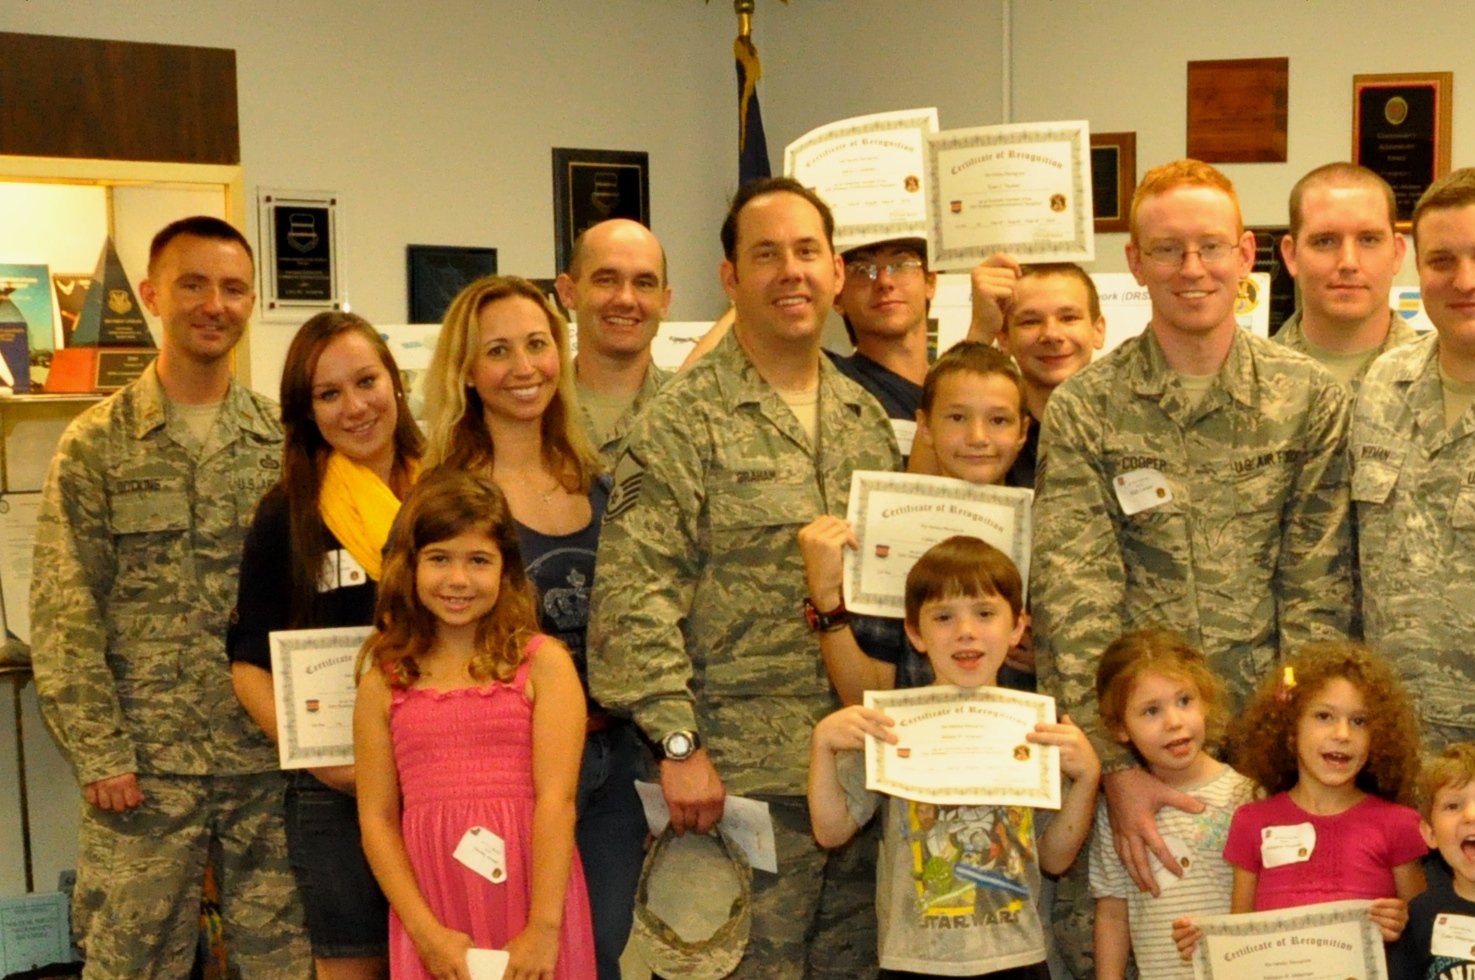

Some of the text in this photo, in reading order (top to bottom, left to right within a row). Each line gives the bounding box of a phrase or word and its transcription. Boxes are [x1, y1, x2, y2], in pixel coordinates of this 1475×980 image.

[951, 150, 1063, 175] Certificate of Recognition
[1121, 456, 1167, 470] COOPER
[882, 504, 932, 519] Certificate
[936, 504, 945, 512] of
[950, 505, 1004, 533] Recognition
[305, 655, 352, 675] Certificate
[1224, 936, 1353, 962] Certificate of Recognition
